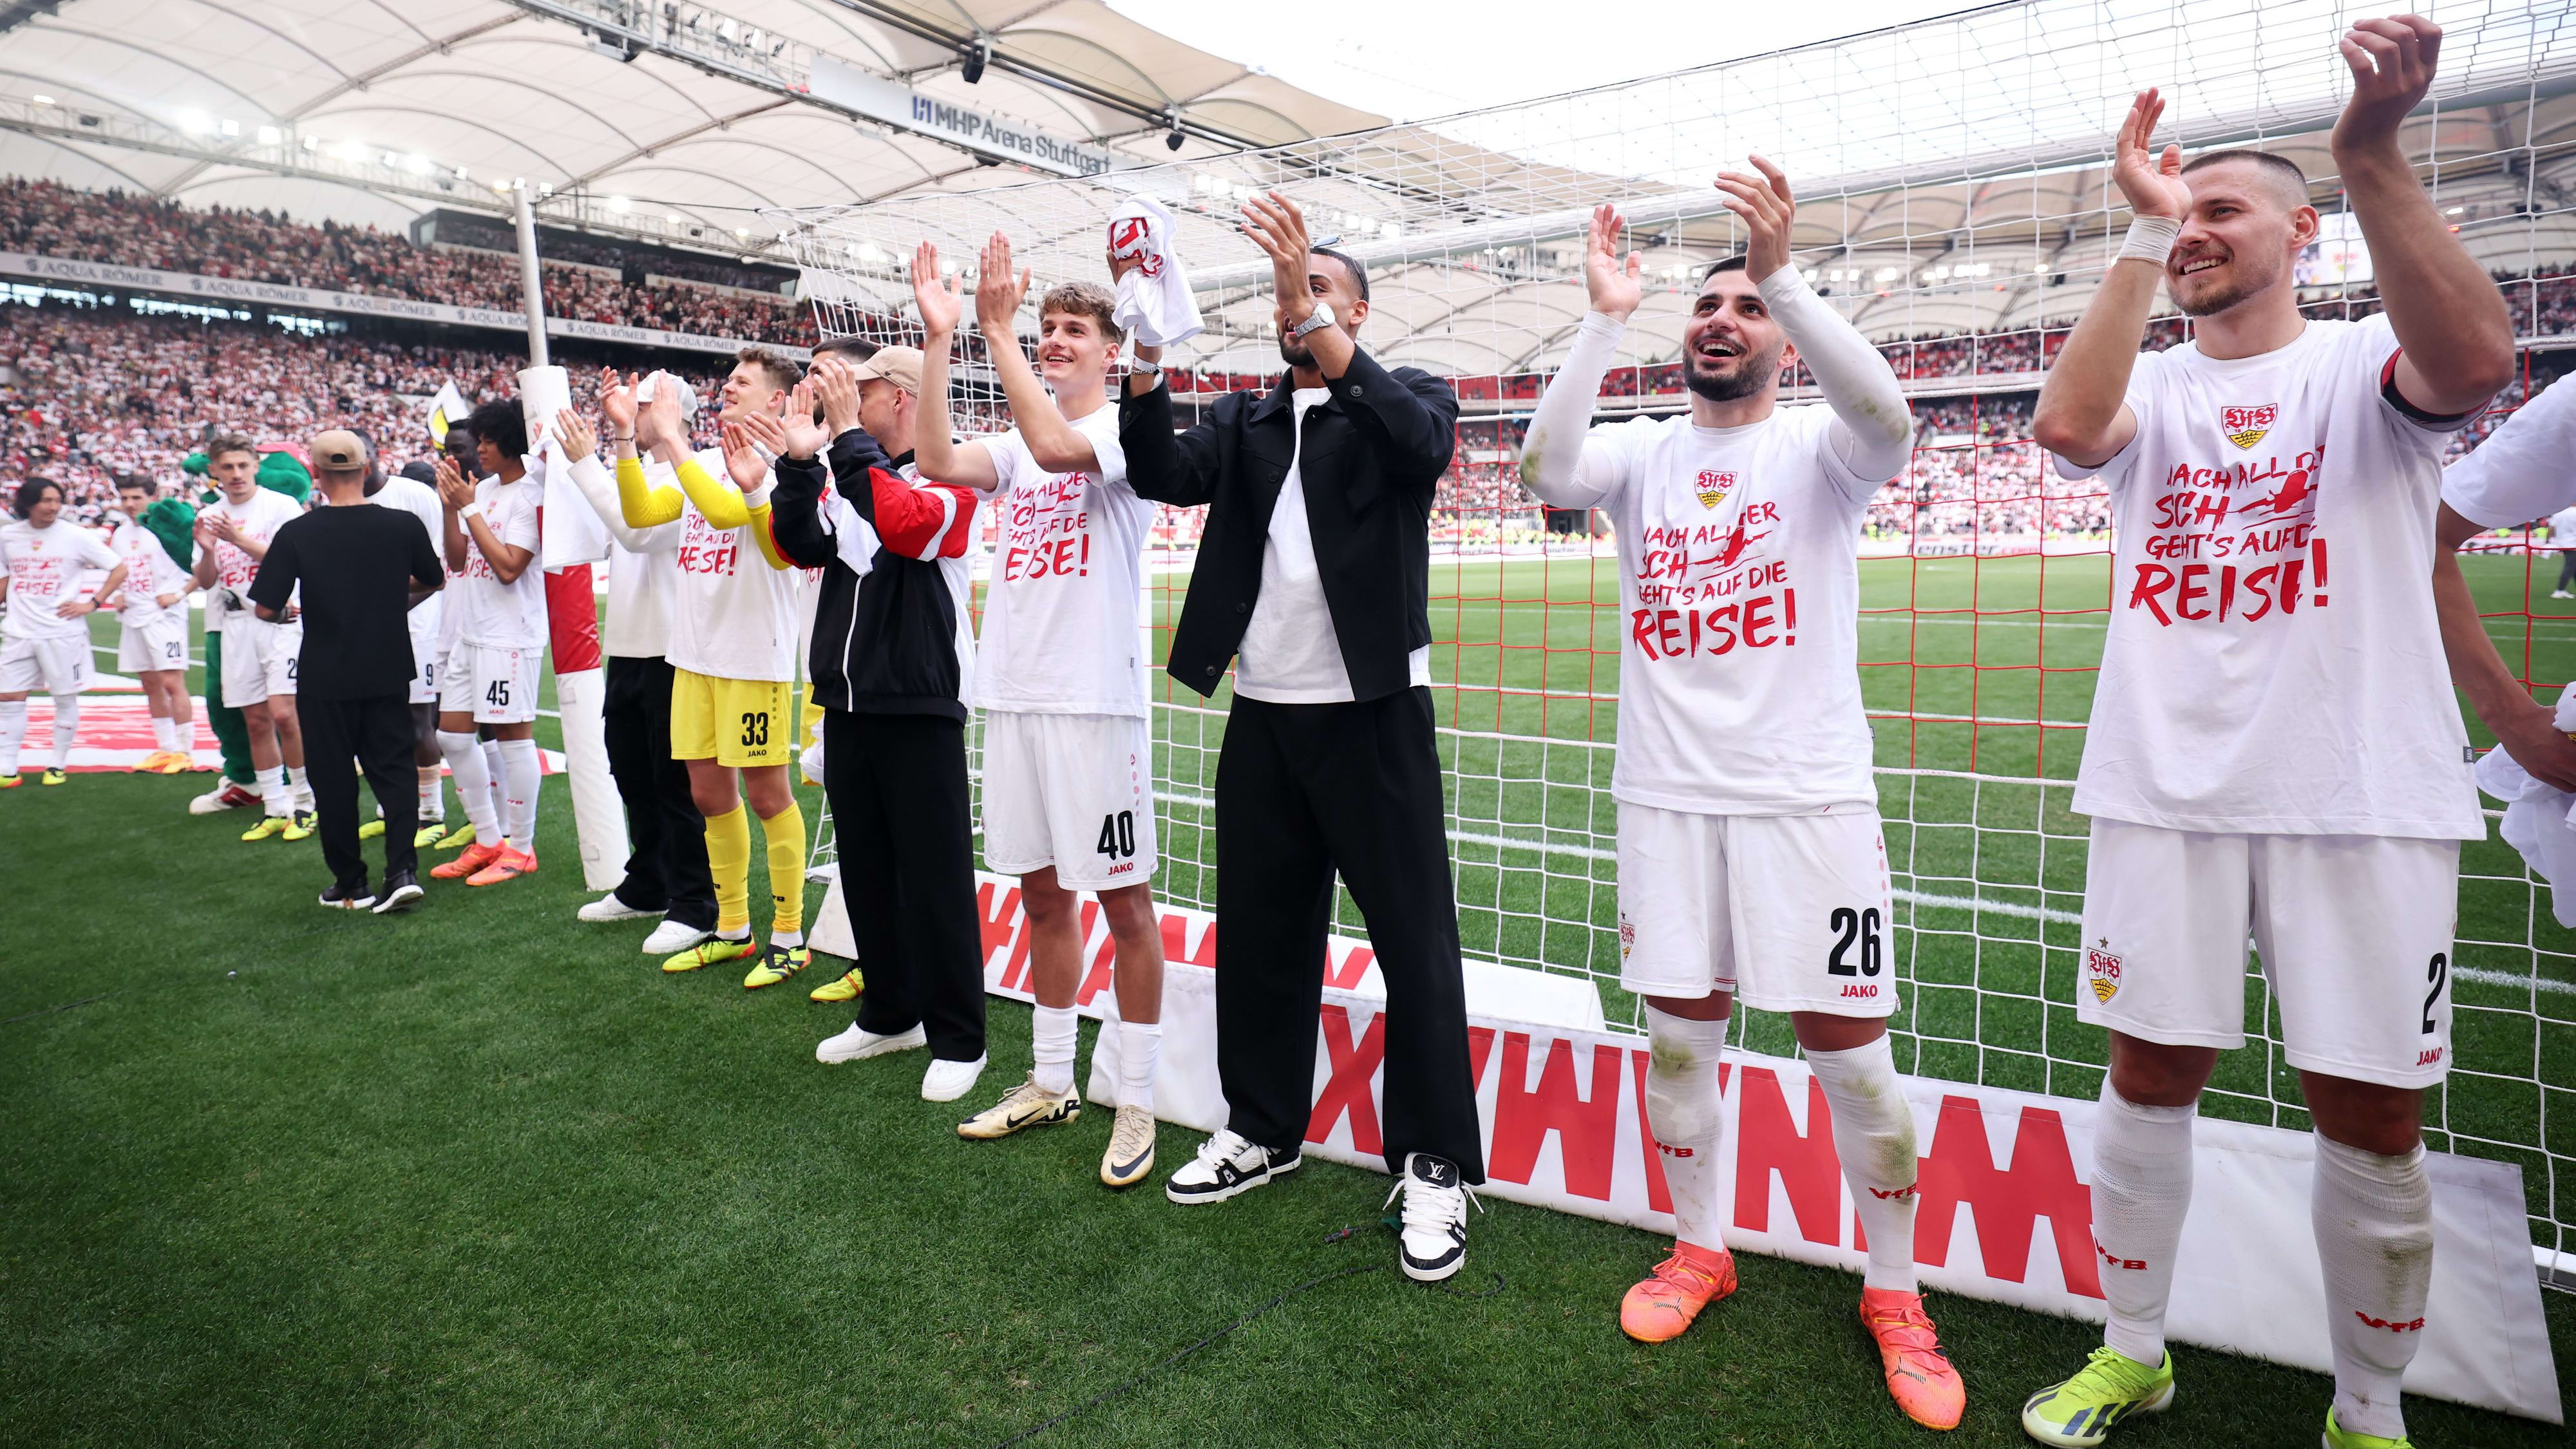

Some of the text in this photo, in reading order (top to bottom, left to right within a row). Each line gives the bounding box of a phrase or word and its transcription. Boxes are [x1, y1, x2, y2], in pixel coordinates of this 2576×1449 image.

[935, 103, 1112, 175] MHP Arena Stuttgart
[43, 261, 164, 285] AQUA RÖMER
[206, 279, 309, 302] AQUA RÖMER
[346, 298, 437, 317] AQU RÖMER
[469, 312, 504, 325] AQUA
[576, 327, 647, 341] AQUA RÖMER
[672, 336, 737, 351] AQUA RÖMER
[786, 348, 811, 361] RÖME
[2224, 406, 2275, 430] VfB
[1696, 471, 1735, 489] VfB
[2237, 457, 2288, 489] ALL
[1004, 533, 1090, 583] EISE!
[2145, 534, 2235, 560] GEHT'S
[1700, 572, 1743, 603] AUF
[1749, 560, 1789, 589] DIE
[2128, 538, 2329, 627] REISE!
[1631, 588, 1796, 662] REISE!
[426, 663, 433, 687] 9
[486, 680, 509, 706] 45
[741, 712, 768, 747] 33
[747, 749, 767, 758] JAKO
[1097, 810, 1135, 861] 40
[1108, 862, 1133, 876] JAKO
[1828, 907, 1881, 977] 26
[1840, 984, 1879, 998] JAKO
[2421, 952, 2447, 1035] 2
[2416, 1046, 2443, 1066] JAKO
